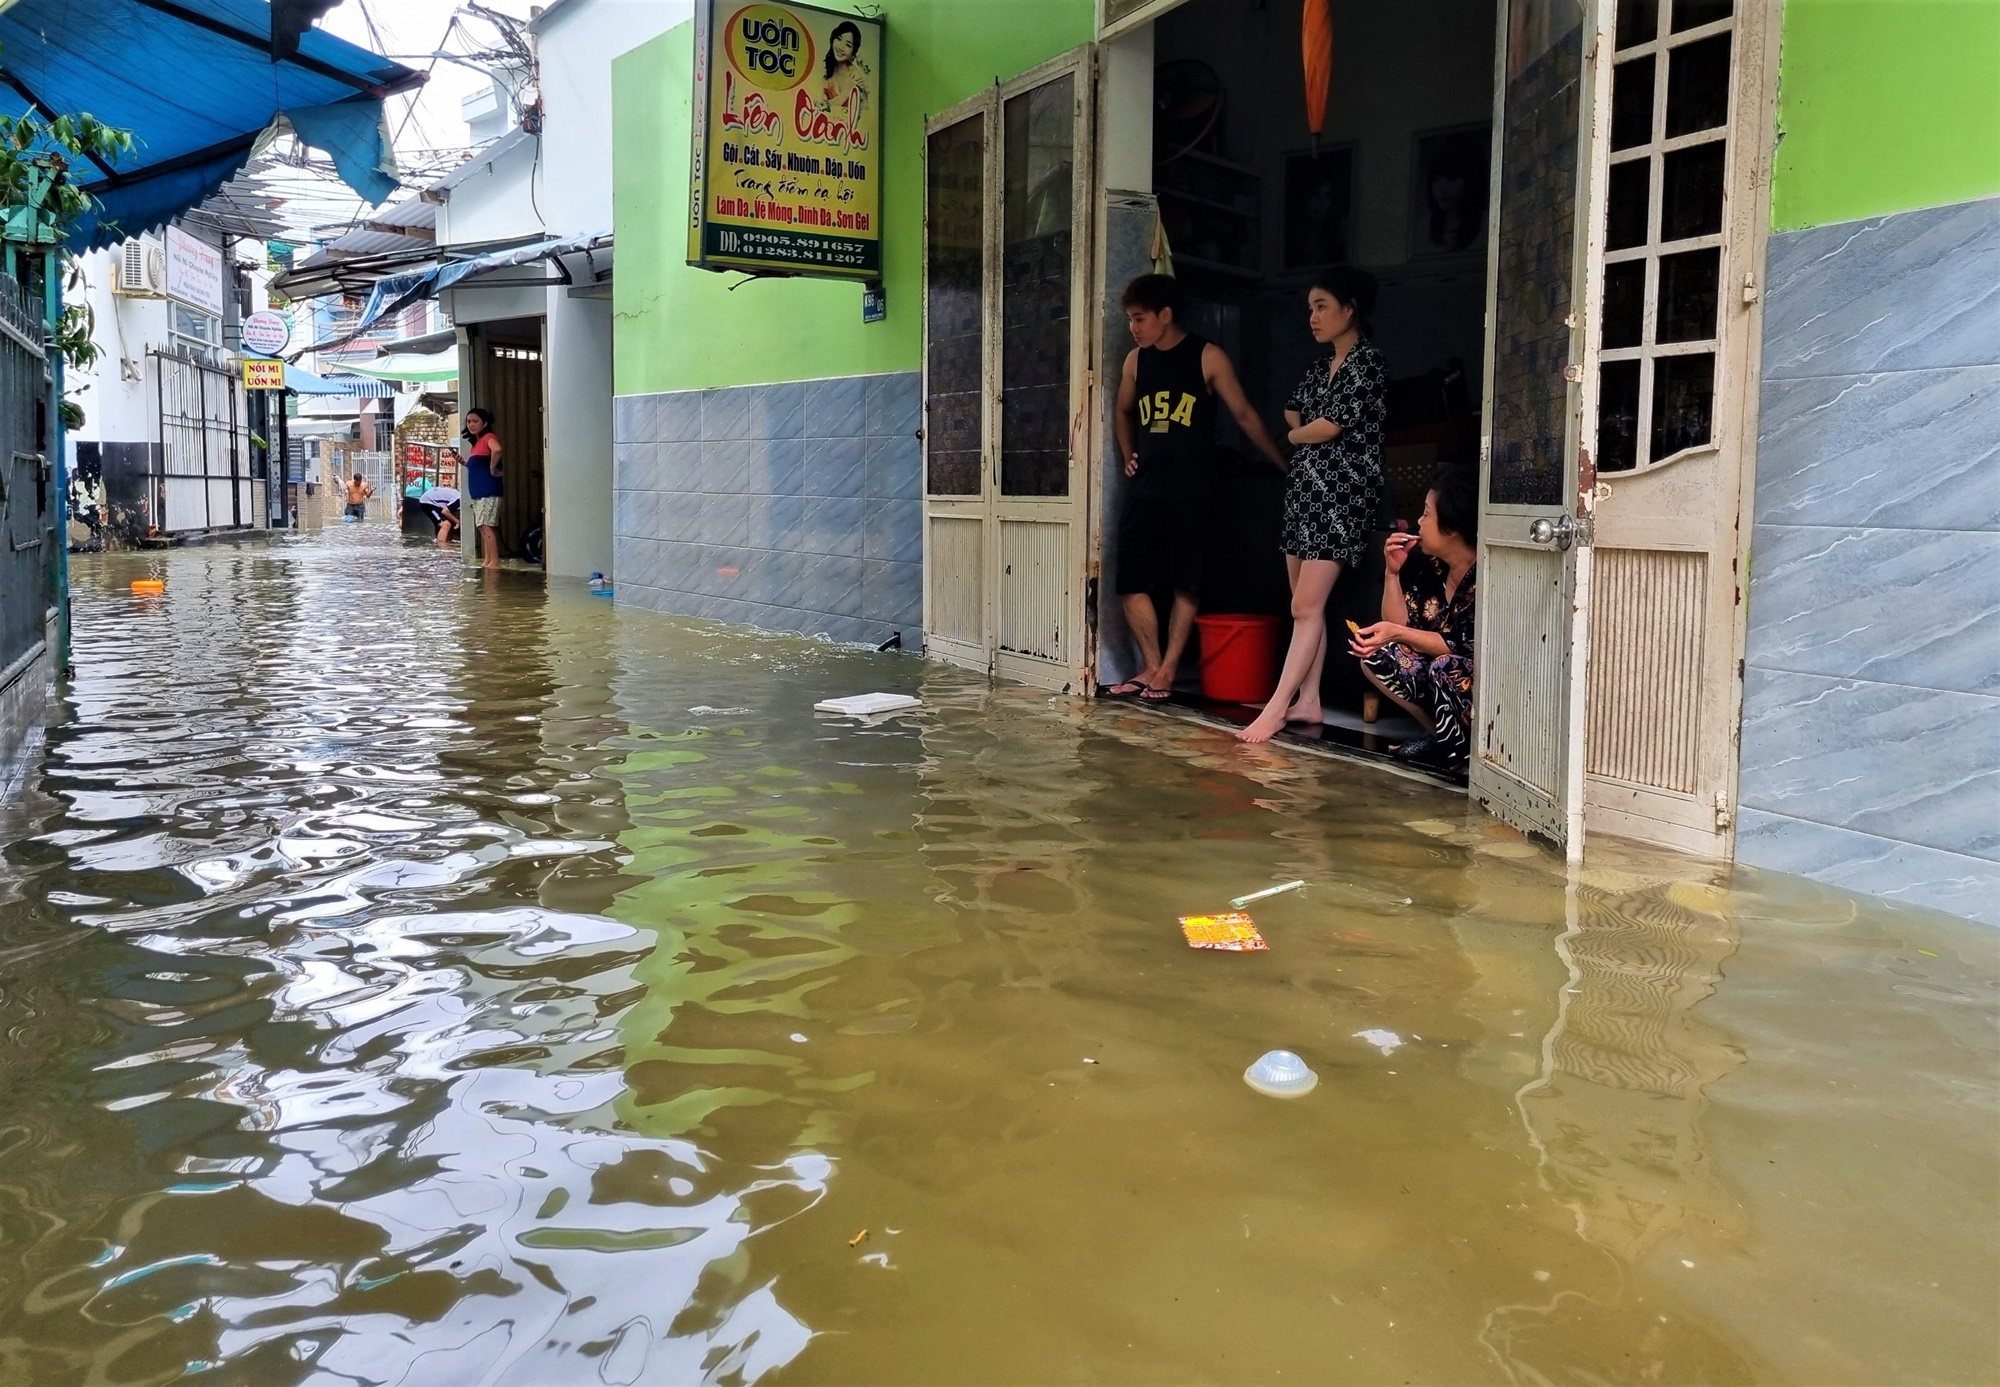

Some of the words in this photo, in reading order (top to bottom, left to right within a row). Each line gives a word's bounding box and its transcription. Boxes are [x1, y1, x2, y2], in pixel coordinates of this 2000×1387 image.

[722, 71, 783, 146] Liên
[794, 86, 869, 155] Oanh
[723, 142, 739, 165] Gội
[744, 144, 760, 166] Cắt
[765, 148, 782, 171] Sấy
[787, 152, 820, 176] Nhuộm
[825, 157, 842, 179] Dập
[848, 161, 866, 180] Uốn
[734, 168, 776, 201] Trang
[716, 195, 735, 216] Làm
[754, 200, 766, 219] Vẽ
[768, 202, 793, 224] Móng
[836, 210, 854, 229] Sơn
[855, 212, 870, 231] Gel
[743, 232, 865, 253] 0905.891657
[743, 244, 865, 264] 01283.811207
[247, 374, 268, 386] UỐN
[270, 378, 281, 386] MI
[248, 361, 266, 373] NỐI
[268, 365, 279, 373] MI
[1138, 390, 1197, 427] USA
